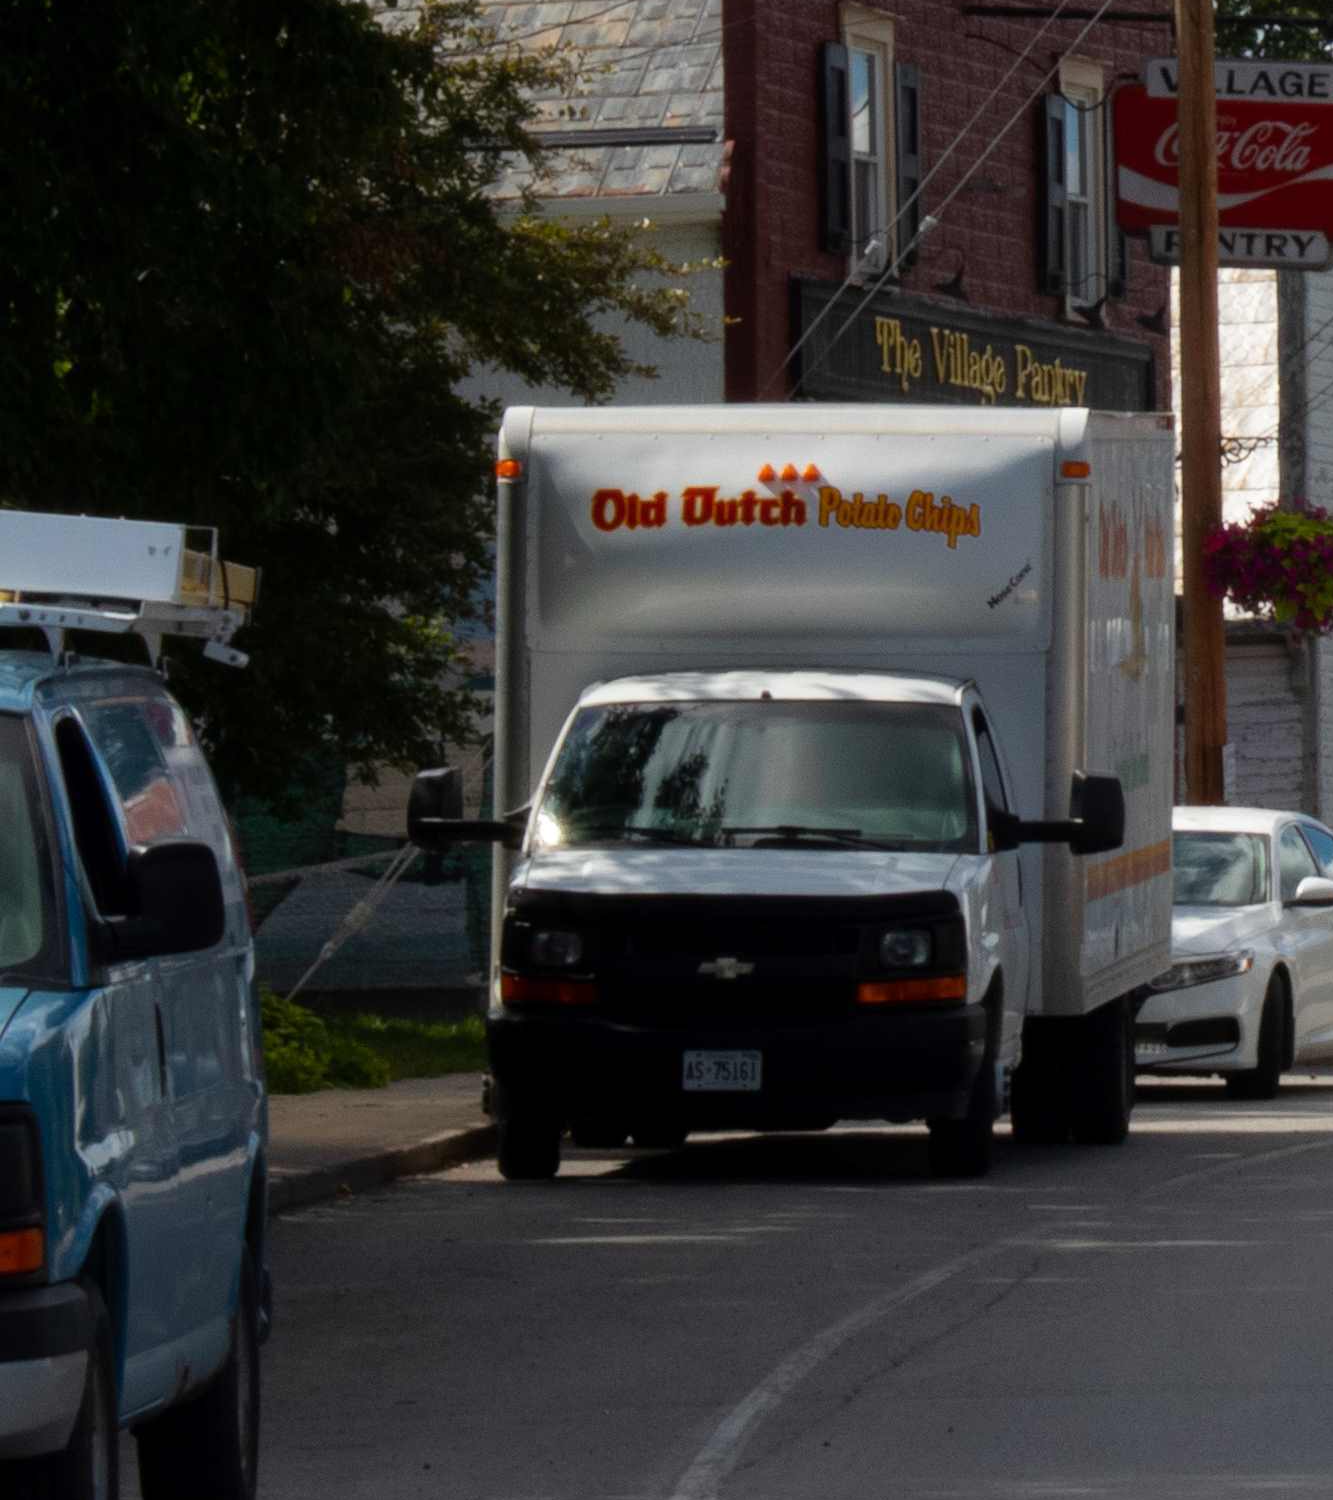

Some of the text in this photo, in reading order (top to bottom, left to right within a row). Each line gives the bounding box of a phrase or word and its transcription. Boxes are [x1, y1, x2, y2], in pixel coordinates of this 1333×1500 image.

[1160, 66, 1331, 97] VLAGE
[1154, 120, 1320, 172] Ca-Cola
[1165, 230, 1316, 258] PNTRY
[875, 316, 1088, 406] The Village Pantry
[592, 486, 982, 549] Old Dutch Potato Chips
